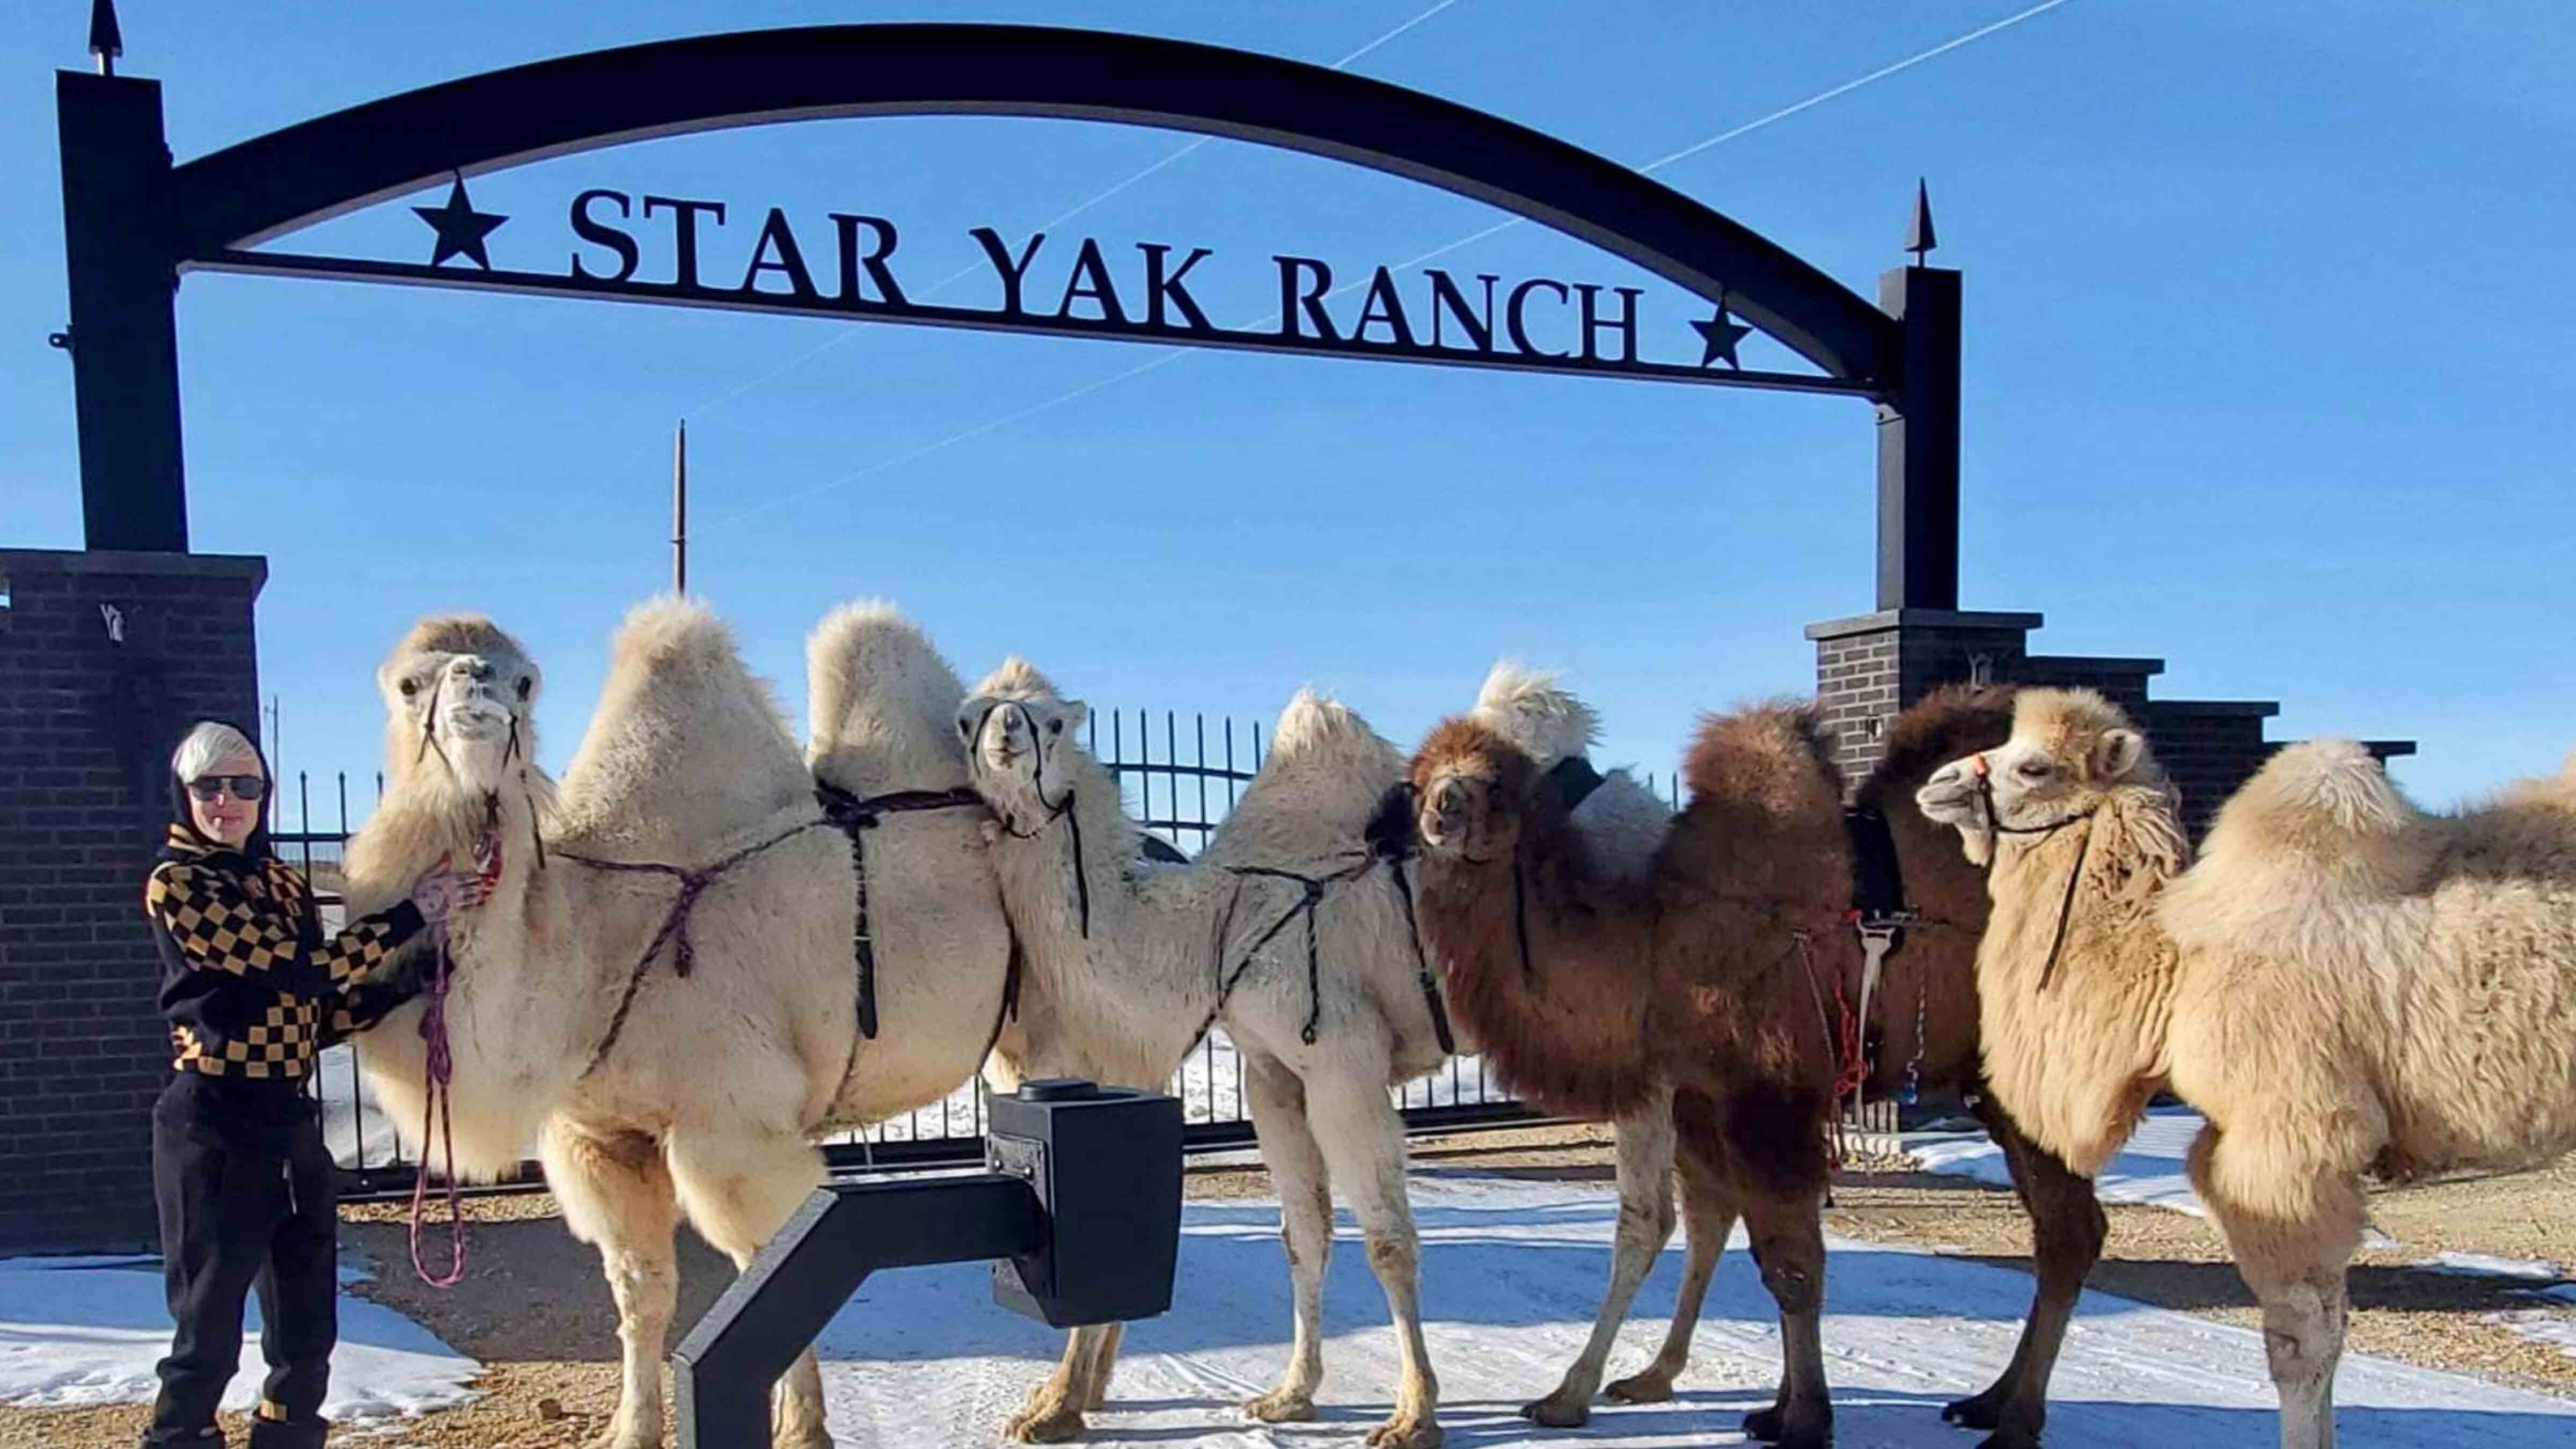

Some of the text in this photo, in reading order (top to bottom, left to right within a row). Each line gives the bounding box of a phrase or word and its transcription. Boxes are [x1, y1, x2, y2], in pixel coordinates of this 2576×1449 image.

[569, 188, 1645, 366] STAR YAK RANCH
